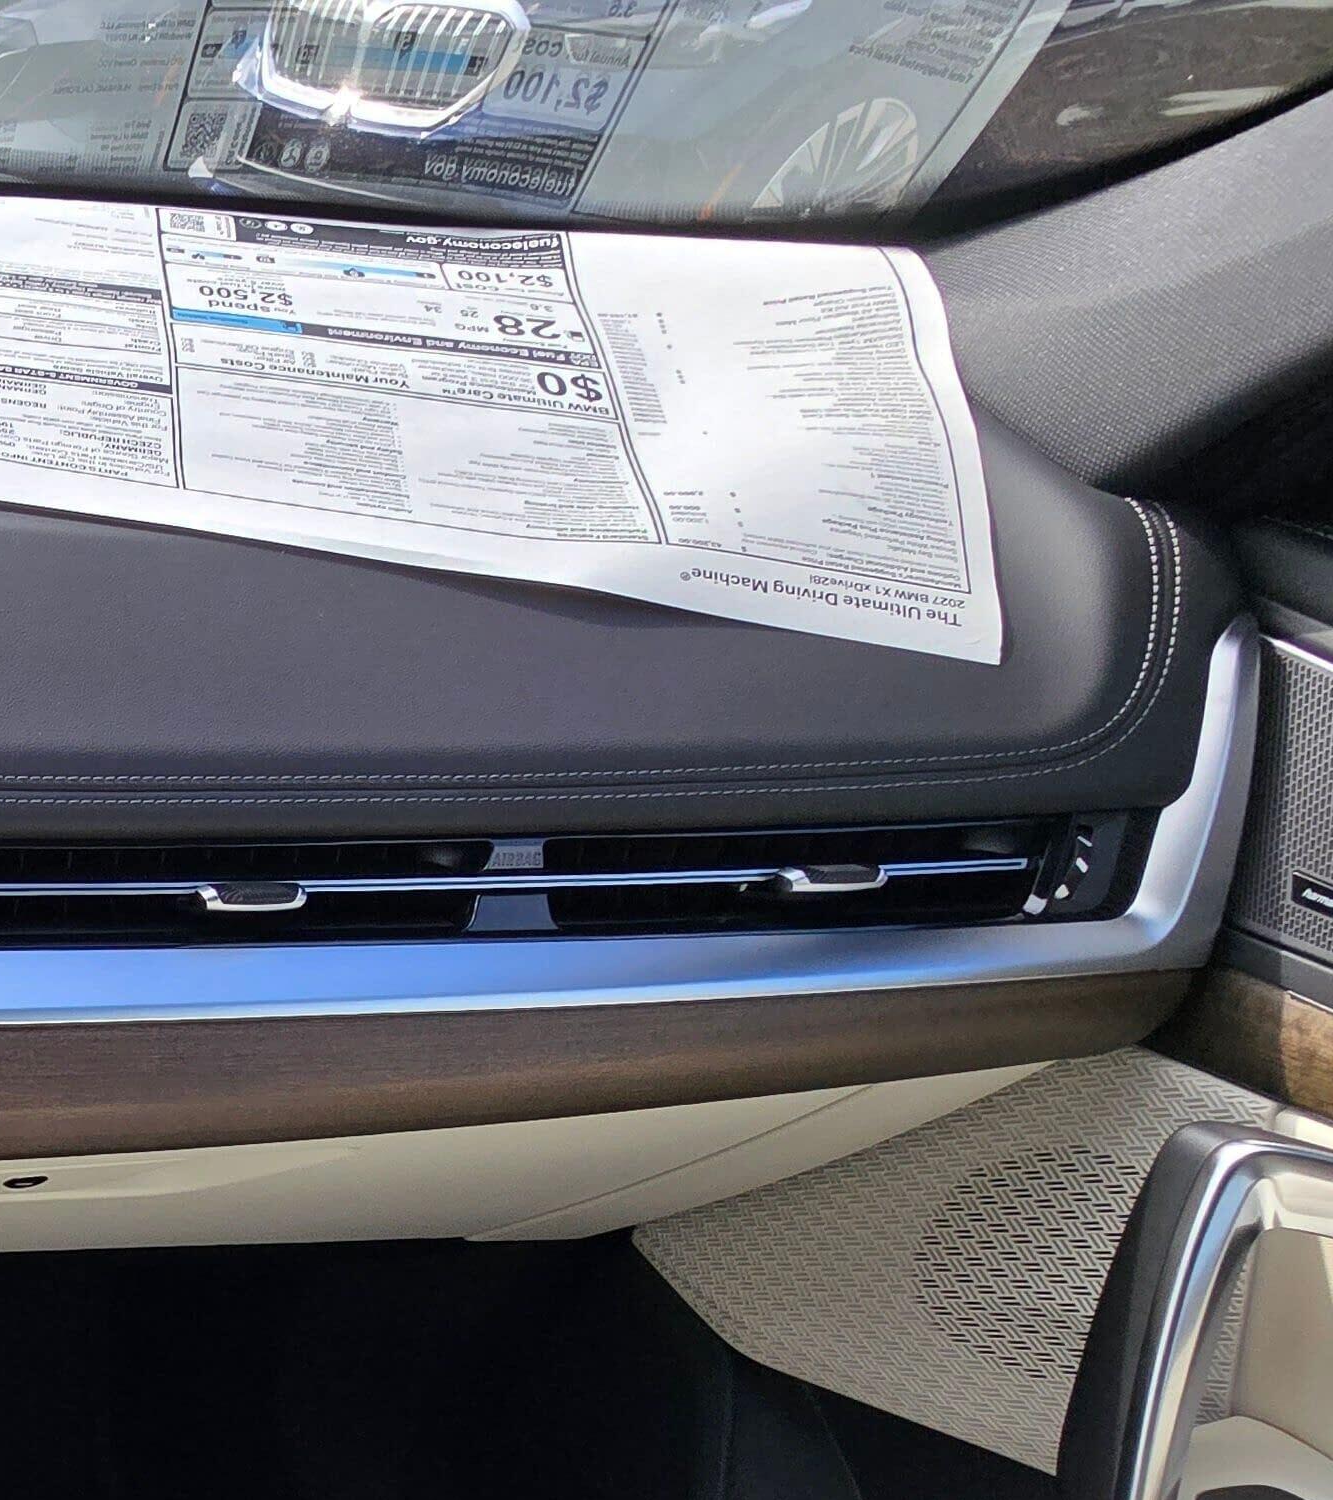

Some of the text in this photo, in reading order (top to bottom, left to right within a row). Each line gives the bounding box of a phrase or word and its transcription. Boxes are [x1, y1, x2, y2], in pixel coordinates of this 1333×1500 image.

[405, 236, 559, 252] fueleconomy.gov
[457, 270, 554, 288] $2,100
[199, 285, 293, 307] $2,500
[423, 304, 443, 314] 34
[459, 309, 479, 319] 25
[493, 314, 561, 340] 28
[219, 357, 410, 390] Your Maintenance Costs
[537, 371, 603, 403] $0
[497, 392, 565, 409] Ultimate
[567, 402, 609, 416] BMW
[773, 580, 838, 606] Driving
[808, 574, 966, 610] 2027 BMW X1 xDrive28i
[843, 595, 921, 620] Ultimate
[926, 609, 963, 627] The
